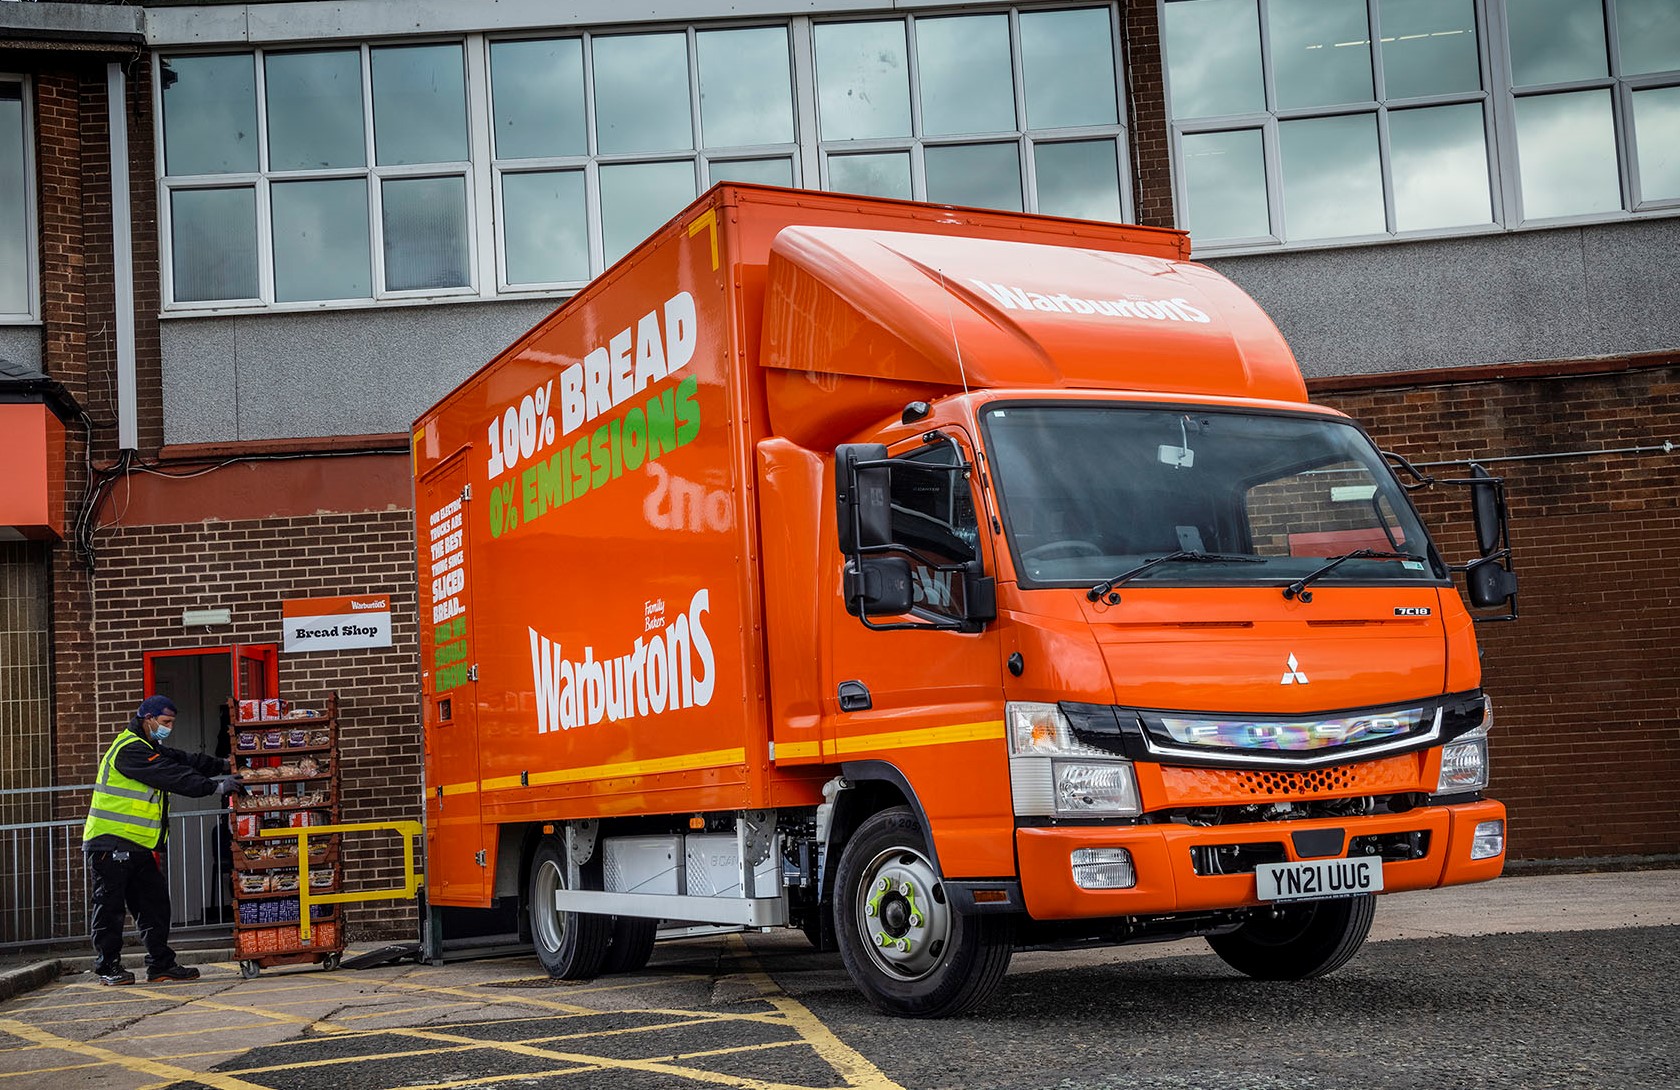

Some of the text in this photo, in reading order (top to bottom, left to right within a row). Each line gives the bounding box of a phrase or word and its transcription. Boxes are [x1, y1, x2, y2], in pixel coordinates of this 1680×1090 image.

[968, 278, 1211, 324] Warburtons
[487, 291, 697, 481] 100% BREAD
[489, 373, 701, 539] 0% EMISSIONS
[430, 512, 462, 542] TRUCKS ARE
[430, 528, 462, 562] THE BEST
[448, 550, 464, 569] SINCE
[432, 567, 465, 604] SLICED
[351, 600, 386, 610] Warburtons
[644, 598, 665, 616] Family
[295, 624, 378, 639] Bread Shop
[644, 615, 666, 632] Bakers
[528, 588, 716, 734] Warburtons
[1185, 717, 1399, 743] FUSO
[1271, 862, 1370, 896] YN21 UUG
